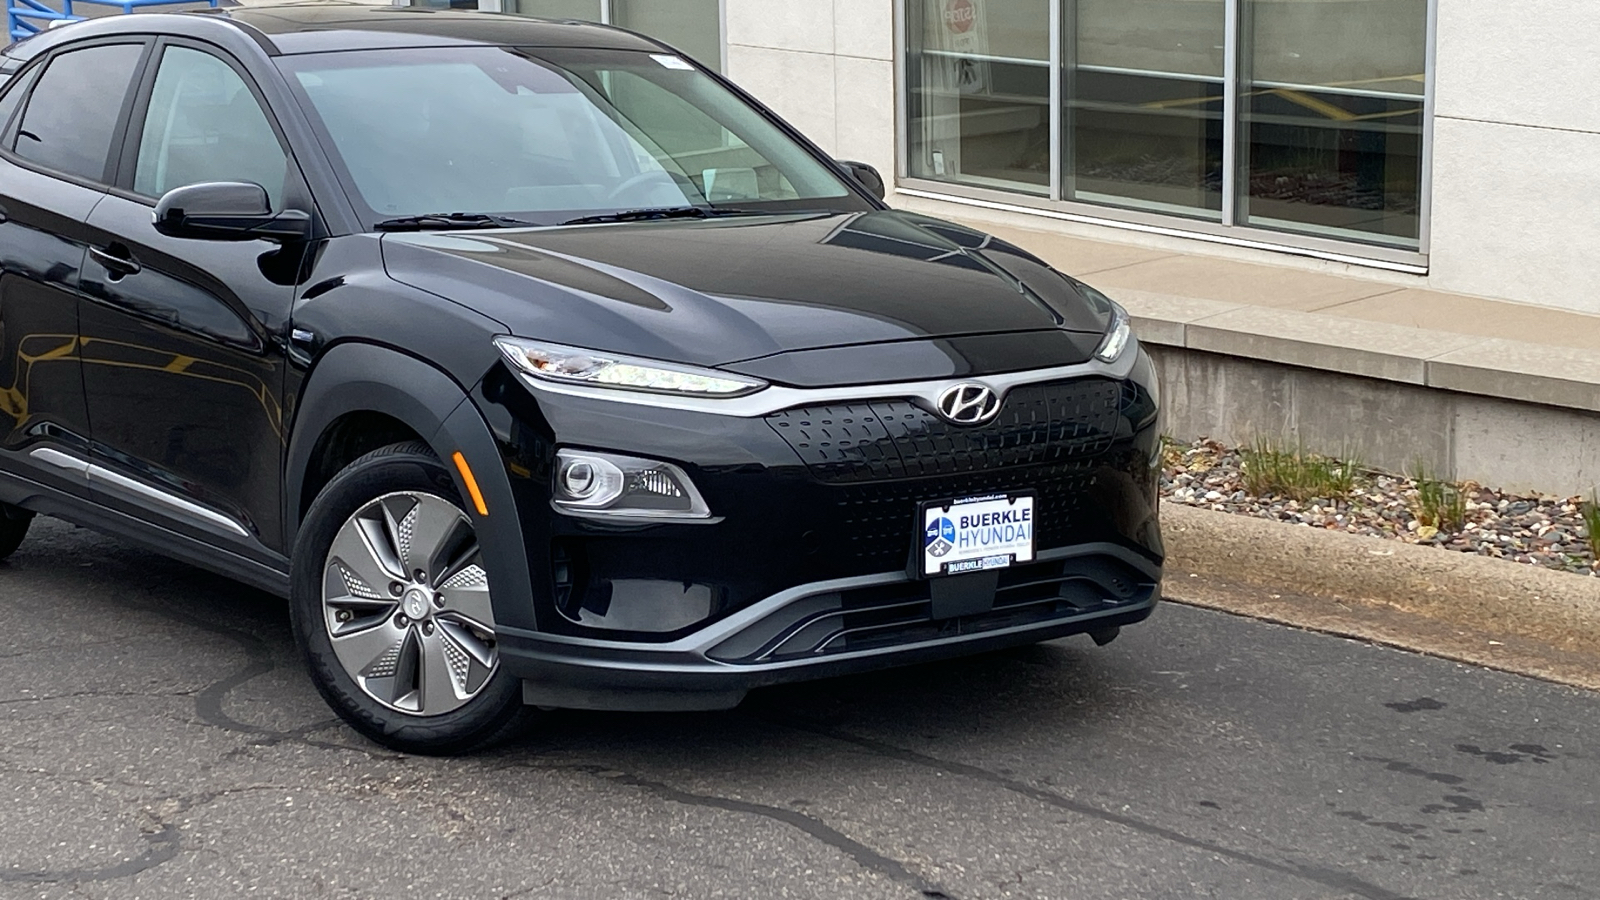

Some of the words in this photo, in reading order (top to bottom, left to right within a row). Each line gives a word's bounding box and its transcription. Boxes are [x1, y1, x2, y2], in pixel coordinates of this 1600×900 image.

[960, 508, 1031, 529] BUERKLE
[959, 523, 1031, 548] HYUNDAI
[949, 560, 983, 572] BUERKLE
